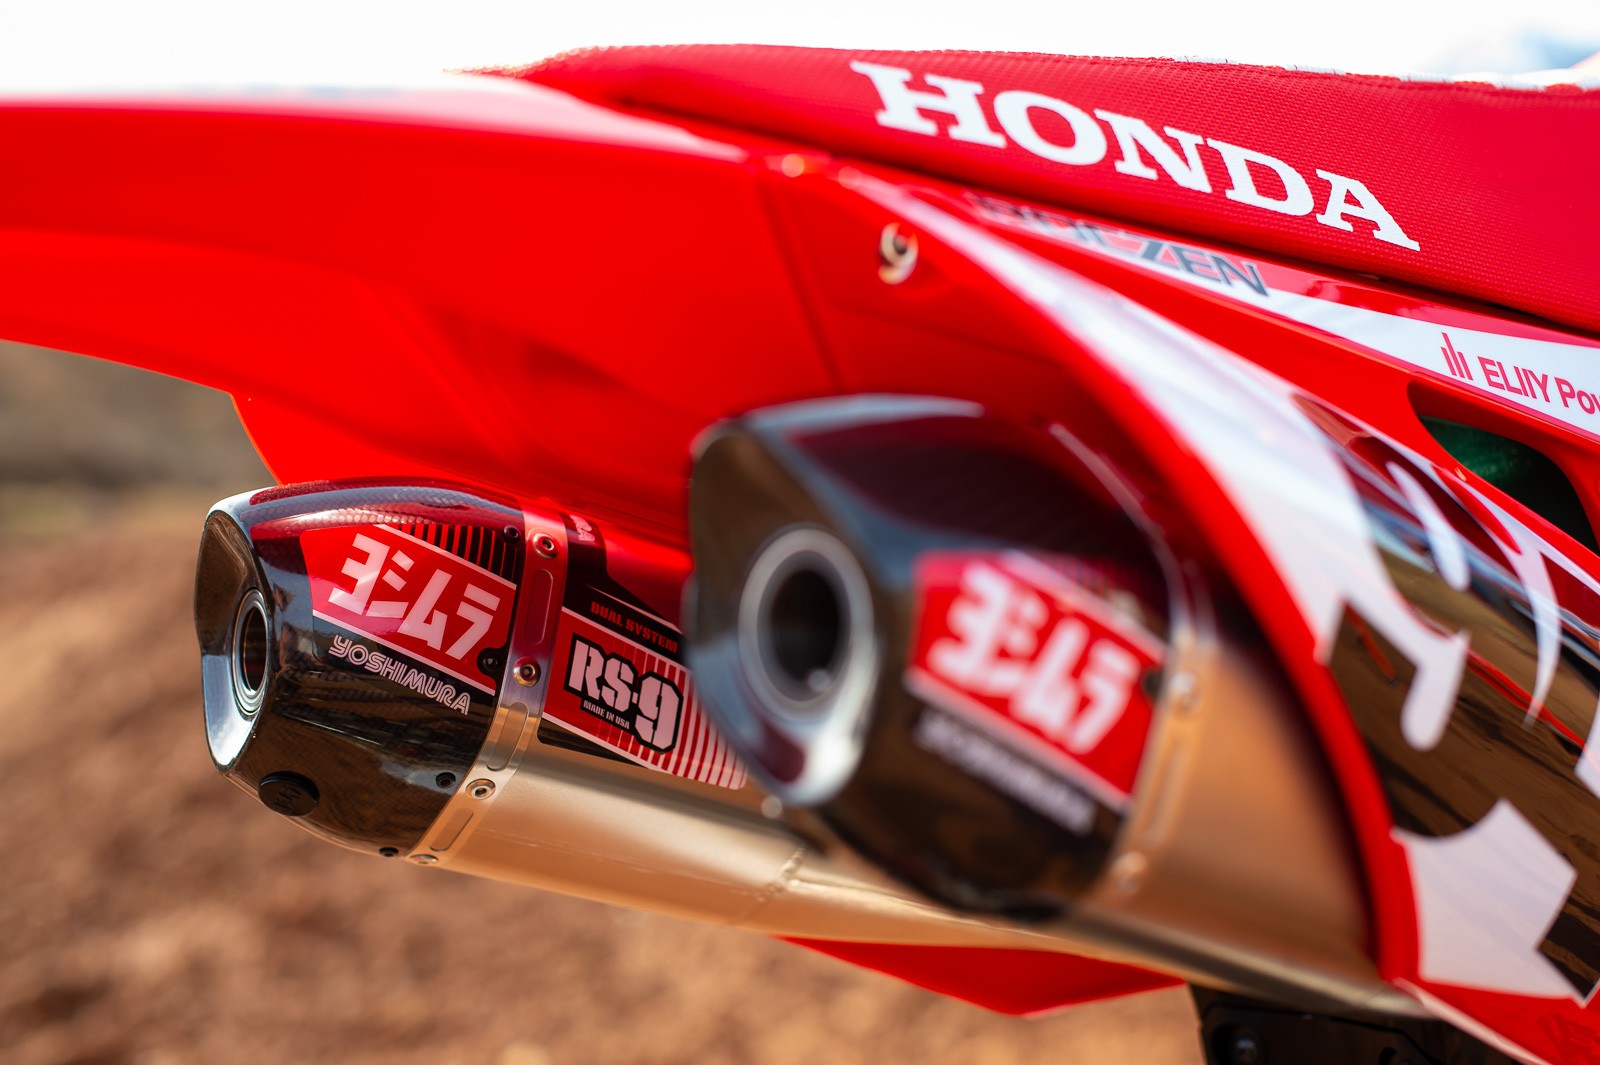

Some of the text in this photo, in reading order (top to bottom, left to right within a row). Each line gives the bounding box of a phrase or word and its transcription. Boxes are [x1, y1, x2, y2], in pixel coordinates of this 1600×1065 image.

[851, 61, 1420, 251] HONDA
[1477, 356, 1551, 403] ELIIY
[328, 533, 500, 660] ヨシムラ
[590, 601, 678, 653] DUAL SYSTEM
[328, 634, 471, 716] YOSHIMURA
[583, 700, 630, 730] MADE IN USA
